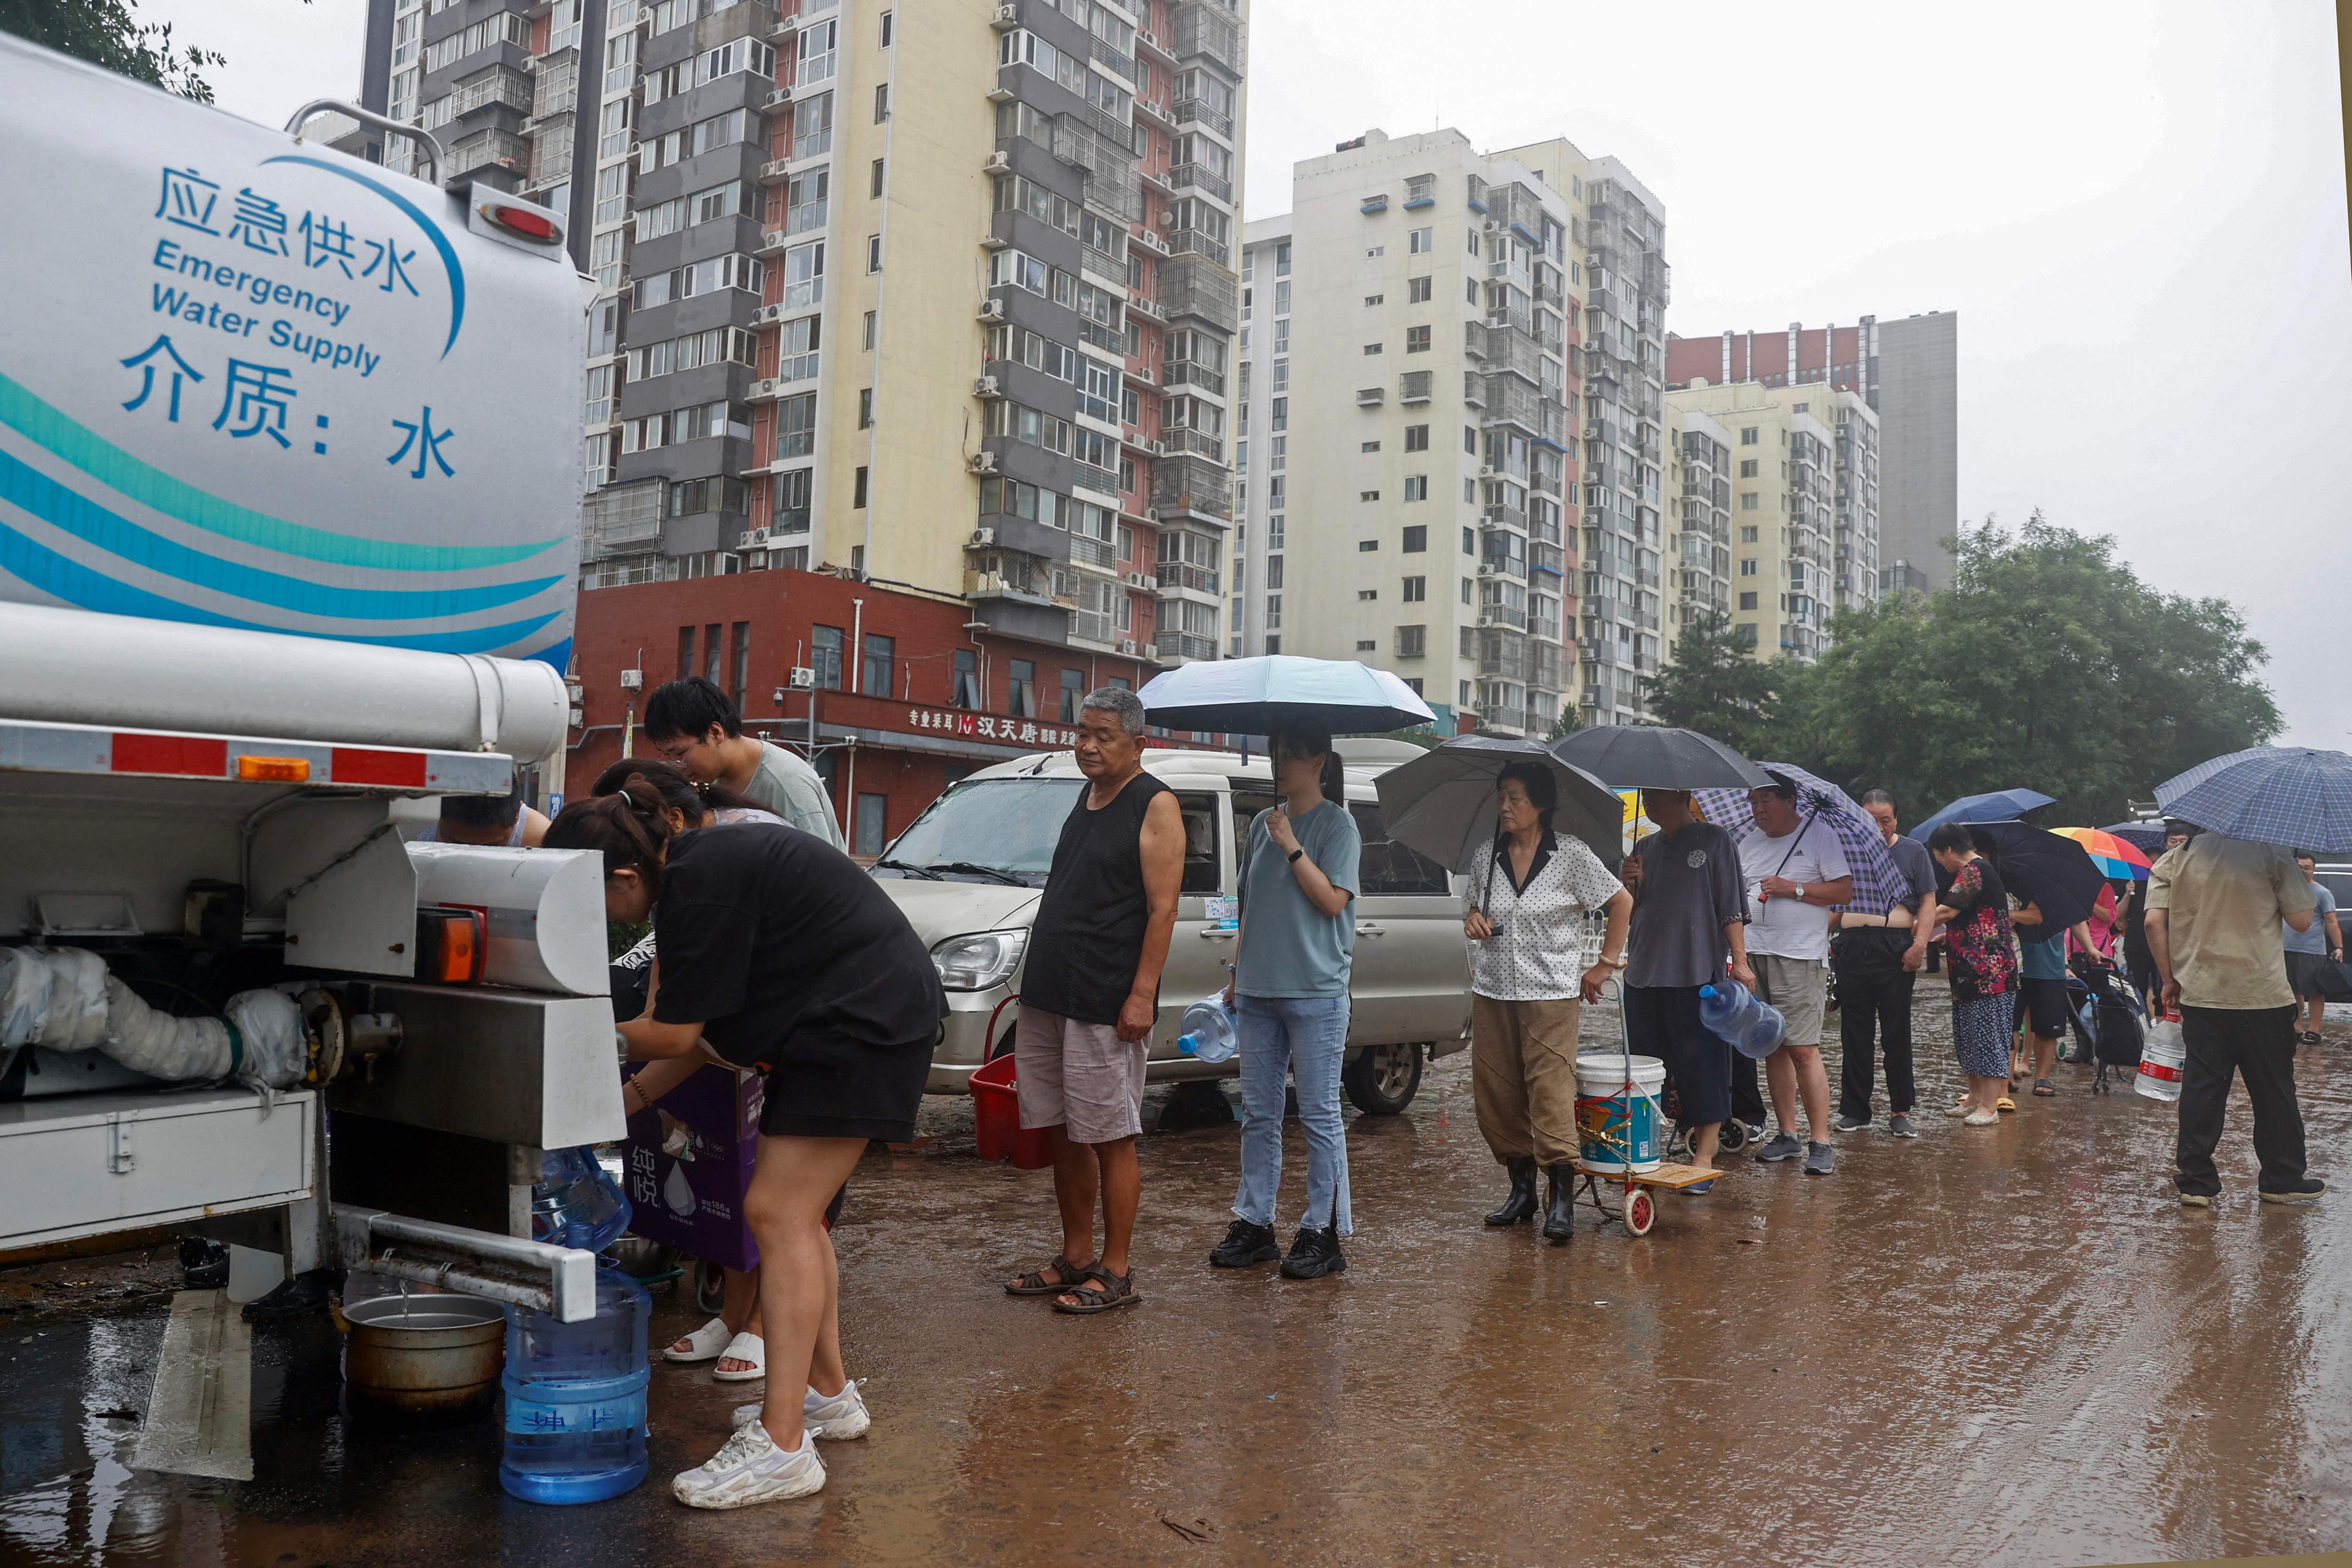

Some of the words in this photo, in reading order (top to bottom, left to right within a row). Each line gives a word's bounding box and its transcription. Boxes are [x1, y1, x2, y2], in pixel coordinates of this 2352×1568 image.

[154, 167, 420, 297] 应急供水
[153, 238, 350, 327] Emergency
[153, 283, 259, 338] Water
[269, 319, 381, 378] Supply
[909, 709, 953, 731] 专业采耳
[977, 716, 1038, 744] 汉天唐
[632, 1145, 659, 1208] 纯悦
